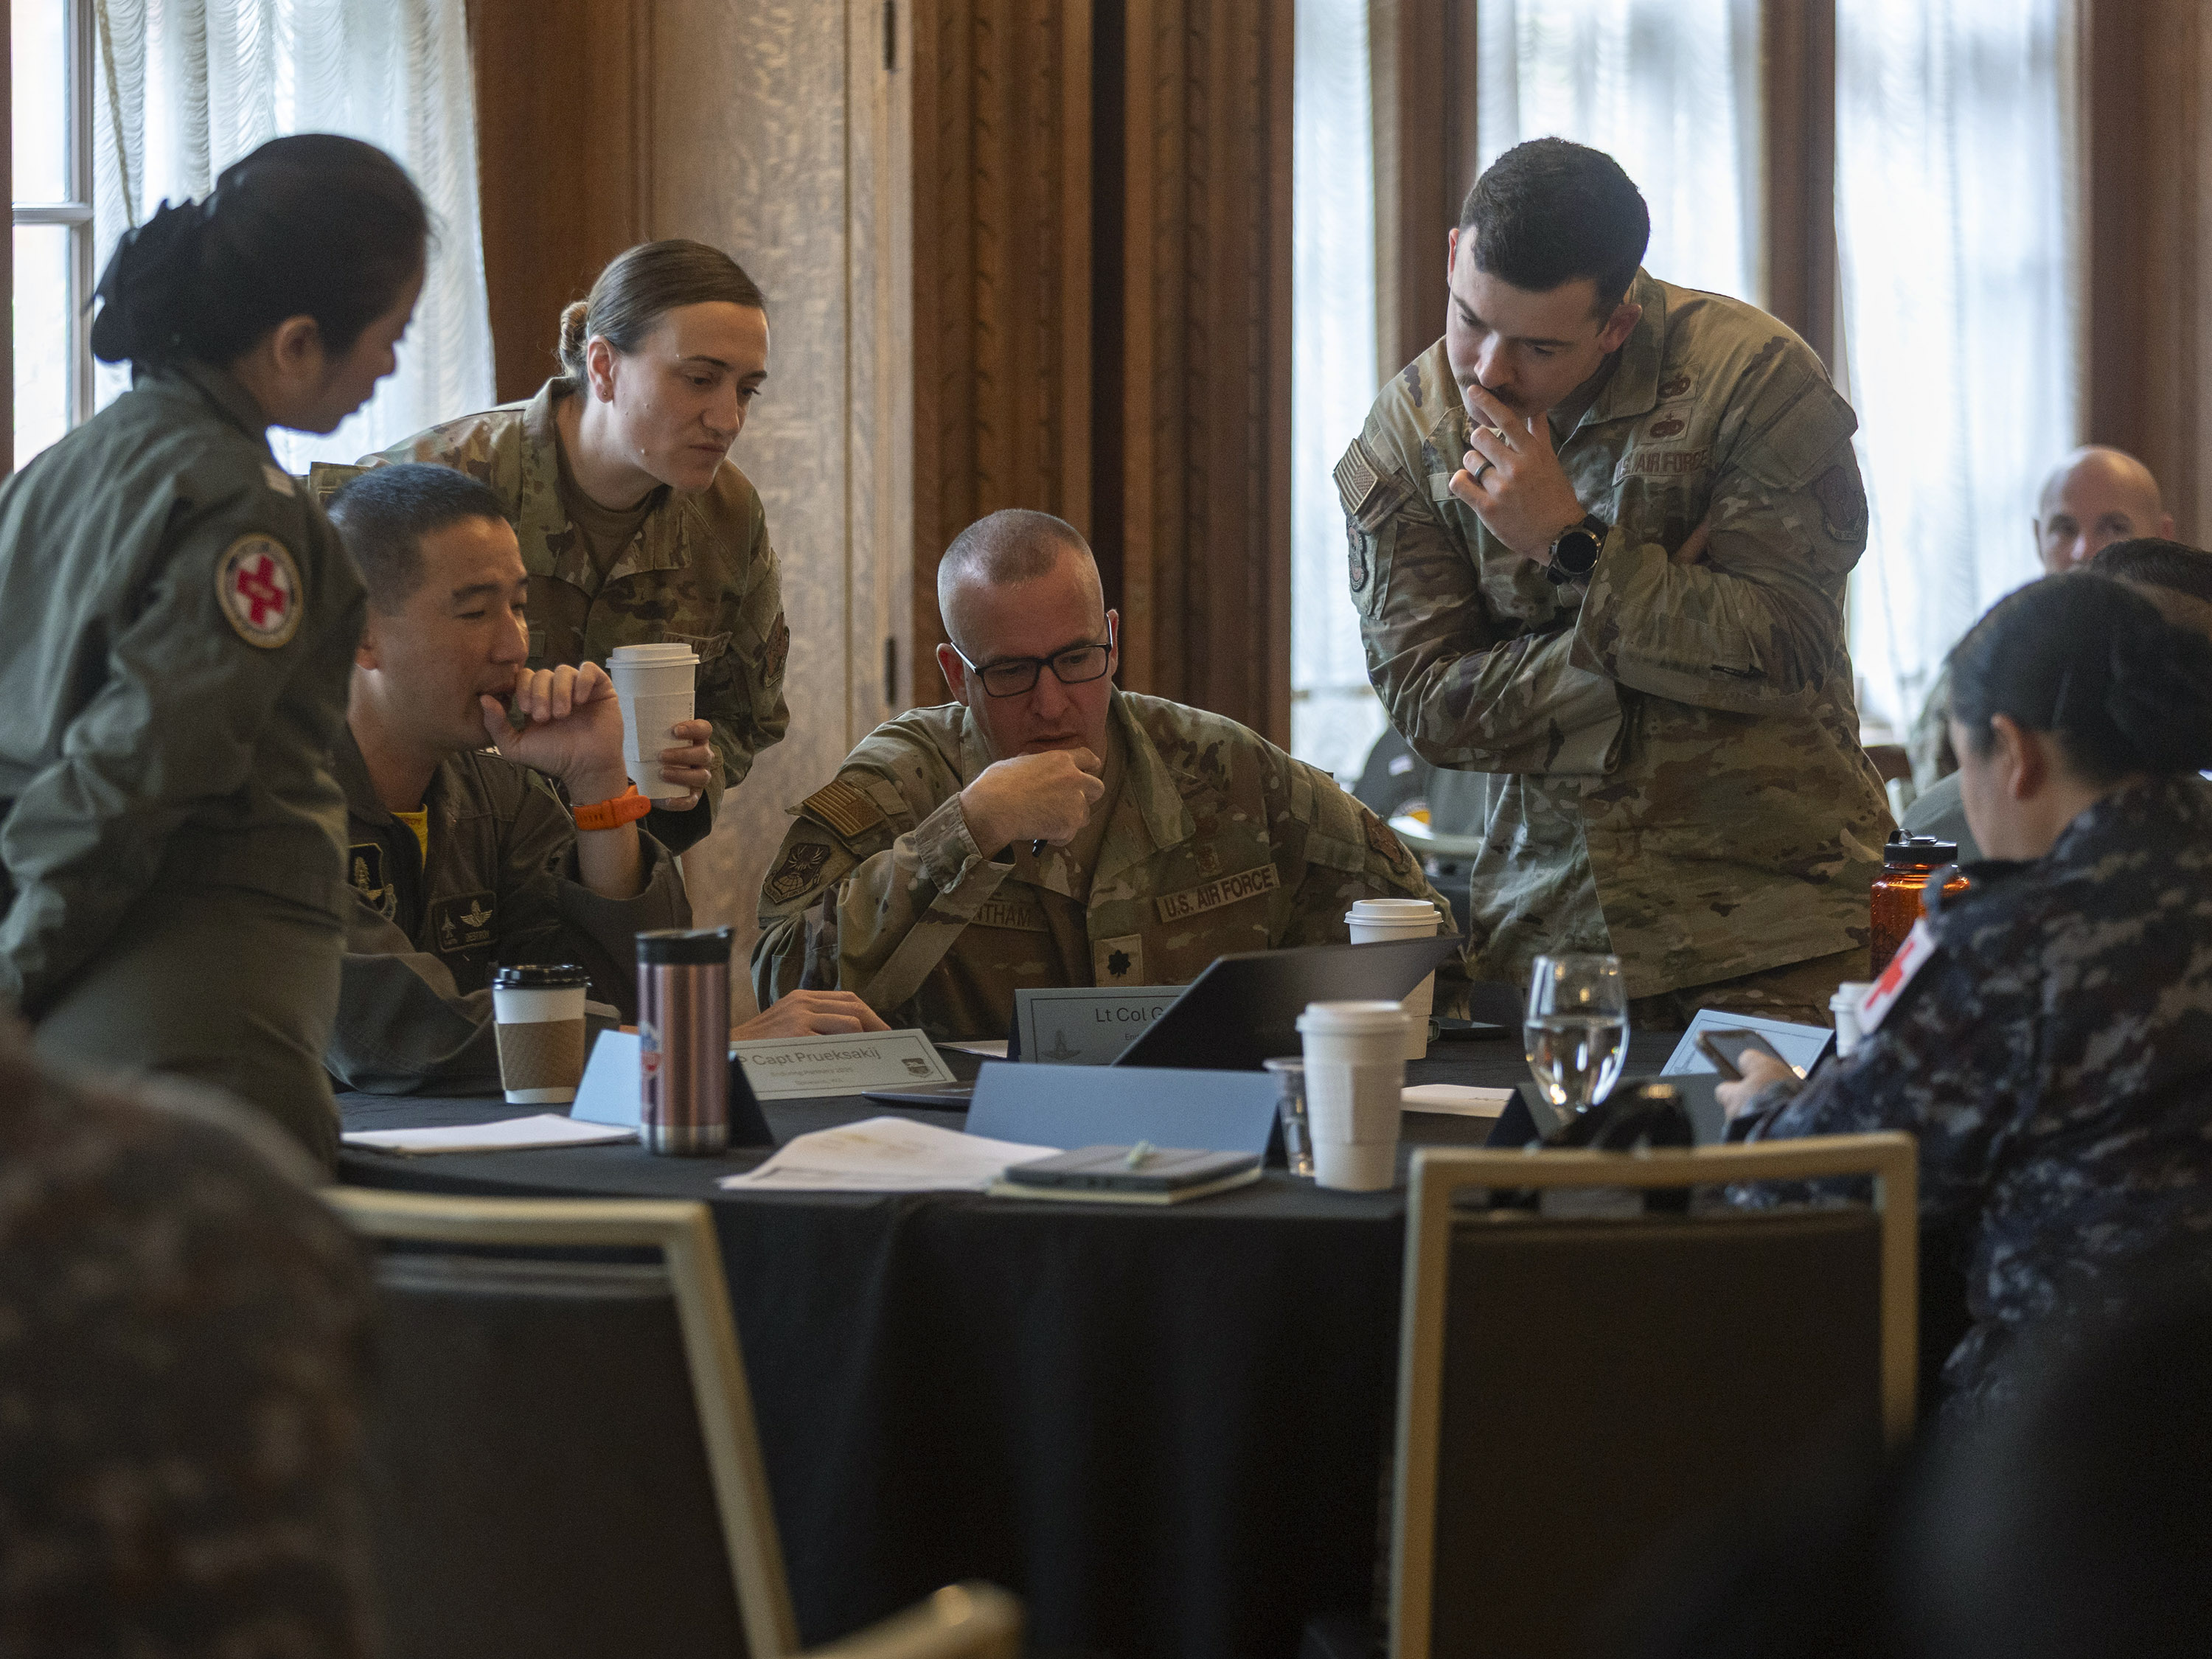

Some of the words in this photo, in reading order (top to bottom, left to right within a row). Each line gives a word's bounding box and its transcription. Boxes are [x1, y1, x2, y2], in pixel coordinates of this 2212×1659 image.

[1635, 453, 1660, 473] AIR
[1663, 450, 1709, 473] FORCE
[1164, 894, 1194, 917] U.S.
[1197, 886, 1221, 909] AIR
[1221, 867, 1273, 900] FORCE
[973, 902, 1031, 927] NTHAM
[1095, 1008, 1112, 1023] Lt
[1116, 1006, 1147, 1022] Col
[1151, 1006, 1164, 1020] G
[751, 1053, 794, 1066] Capt
[794, 1047, 882, 1062] Prueksakij
